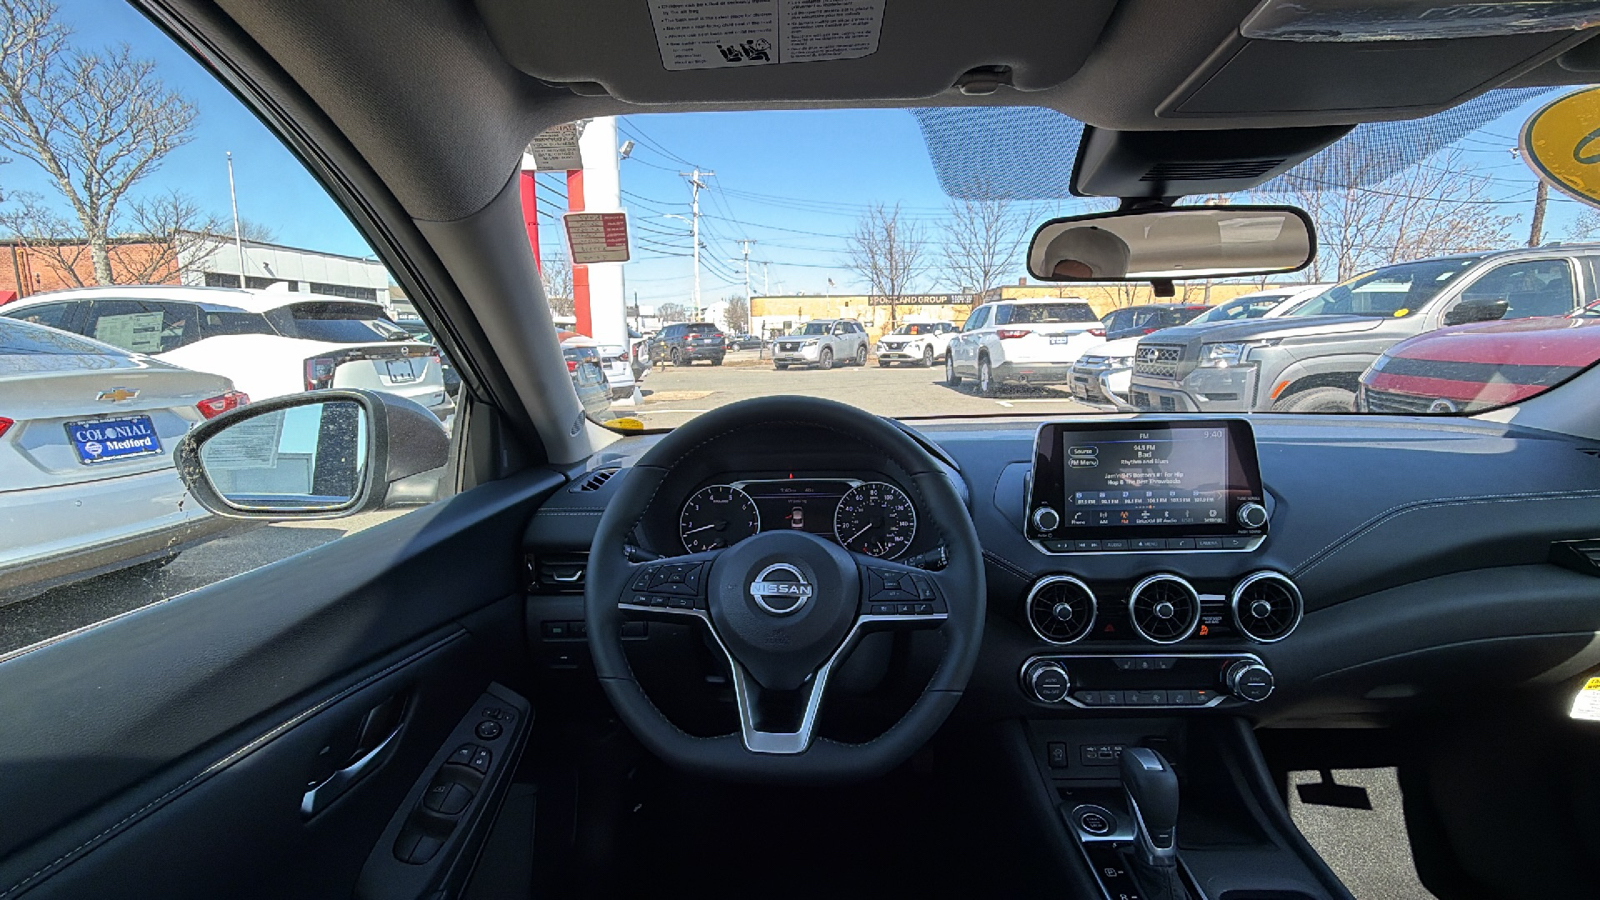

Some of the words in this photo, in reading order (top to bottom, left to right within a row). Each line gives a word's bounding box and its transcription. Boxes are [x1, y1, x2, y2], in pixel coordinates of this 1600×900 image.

[1203, 430, 1223, 439] 9:40
[106, 437, 152, 451] Medford
[754, 584, 811, 595] NISSAN
